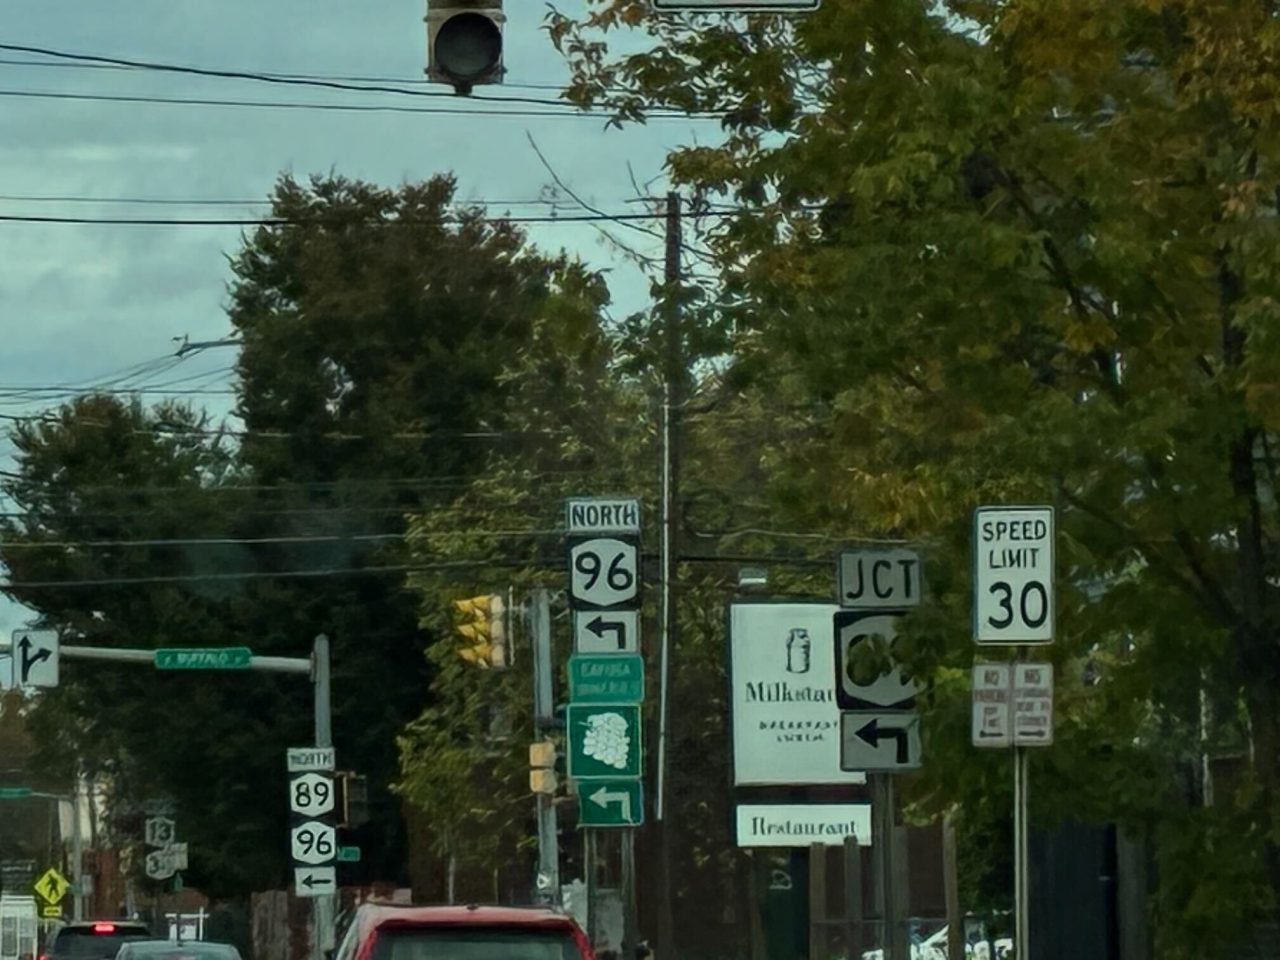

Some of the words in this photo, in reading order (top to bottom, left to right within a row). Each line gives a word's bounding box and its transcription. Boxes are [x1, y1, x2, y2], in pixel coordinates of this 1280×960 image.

[572, 503, 637, 527] NORTH
[981, 520, 1047, 542] SPEED
[575, 551, 634, 591] 96
[989, 548, 1039, 569] LIMIT
[846, 558, 917, 599] JCT
[988, 580, 1048, 629] 30
[296, 782, 329, 807] 89
[752, 816, 856, 835] Restaurant
[297, 830, 332, 855] 96
